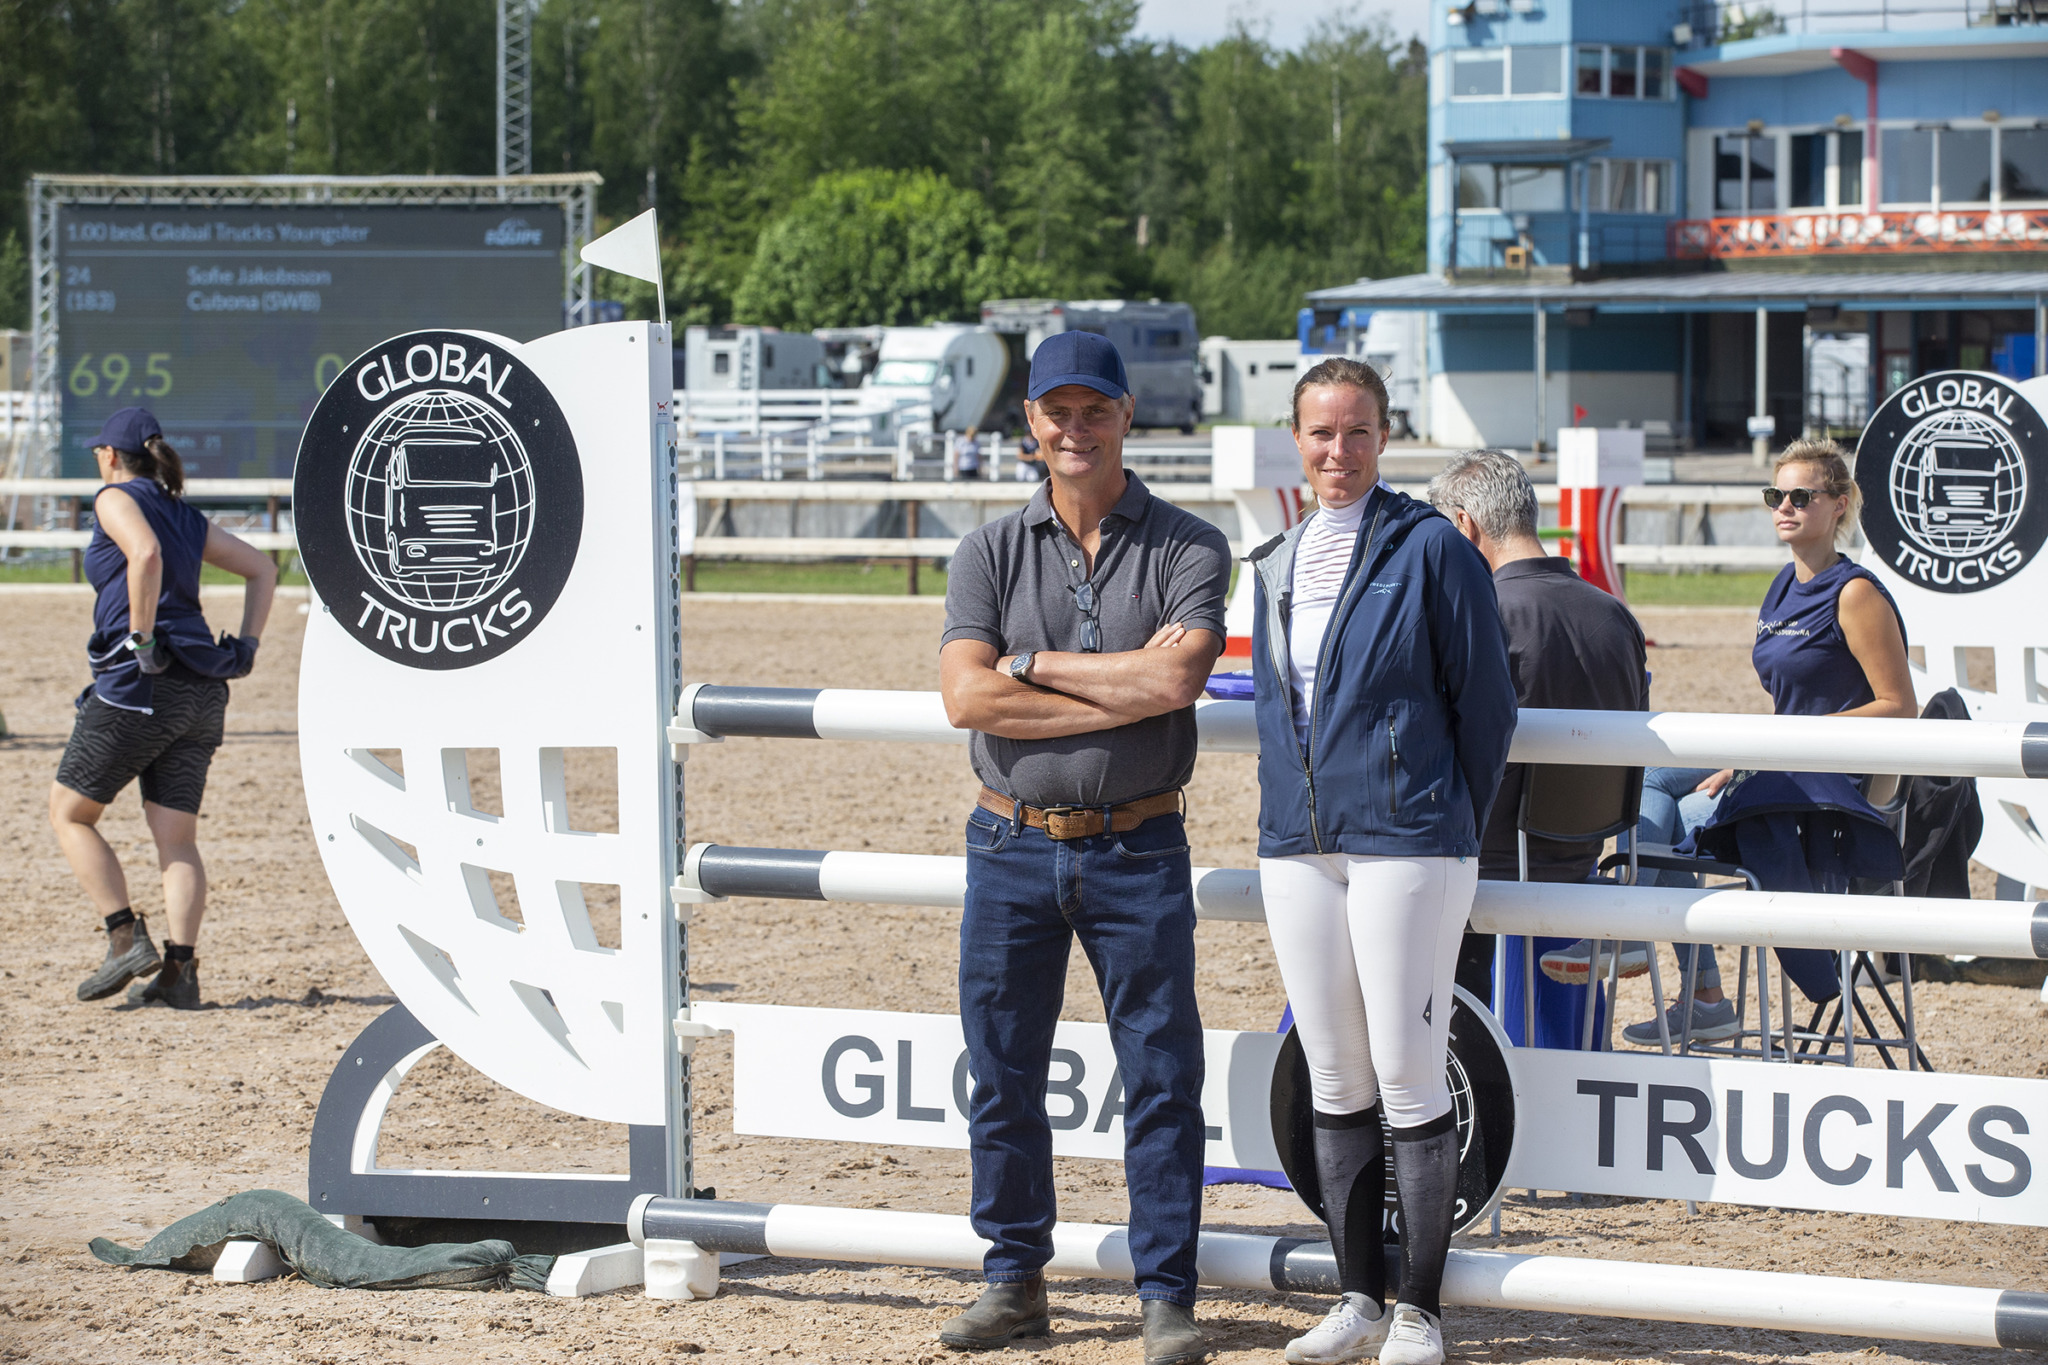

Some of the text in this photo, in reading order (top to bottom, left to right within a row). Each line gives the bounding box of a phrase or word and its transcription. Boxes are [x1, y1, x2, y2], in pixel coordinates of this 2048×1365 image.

[66, 222, 108, 242] 1.00
[150, 222, 211, 242] Global
[215, 222, 275, 242] Trucks
[277, 222, 371, 246] Youngster
[66, 265, 332, 286] 24 Sofie Jakobsson
[187, 290, 260, 311] Cubona
[68, 352, 173, 398] 69.5
[356, 343, 513, 408] GLOBAL
[1901, 379, 2014, 426] GLOBAL
[1895, 540, 2022, 585] TRUCKS
[357, 587, 533, 654] TRUCKS
[1577, 1078, 2032, 1198] TRUCKS
